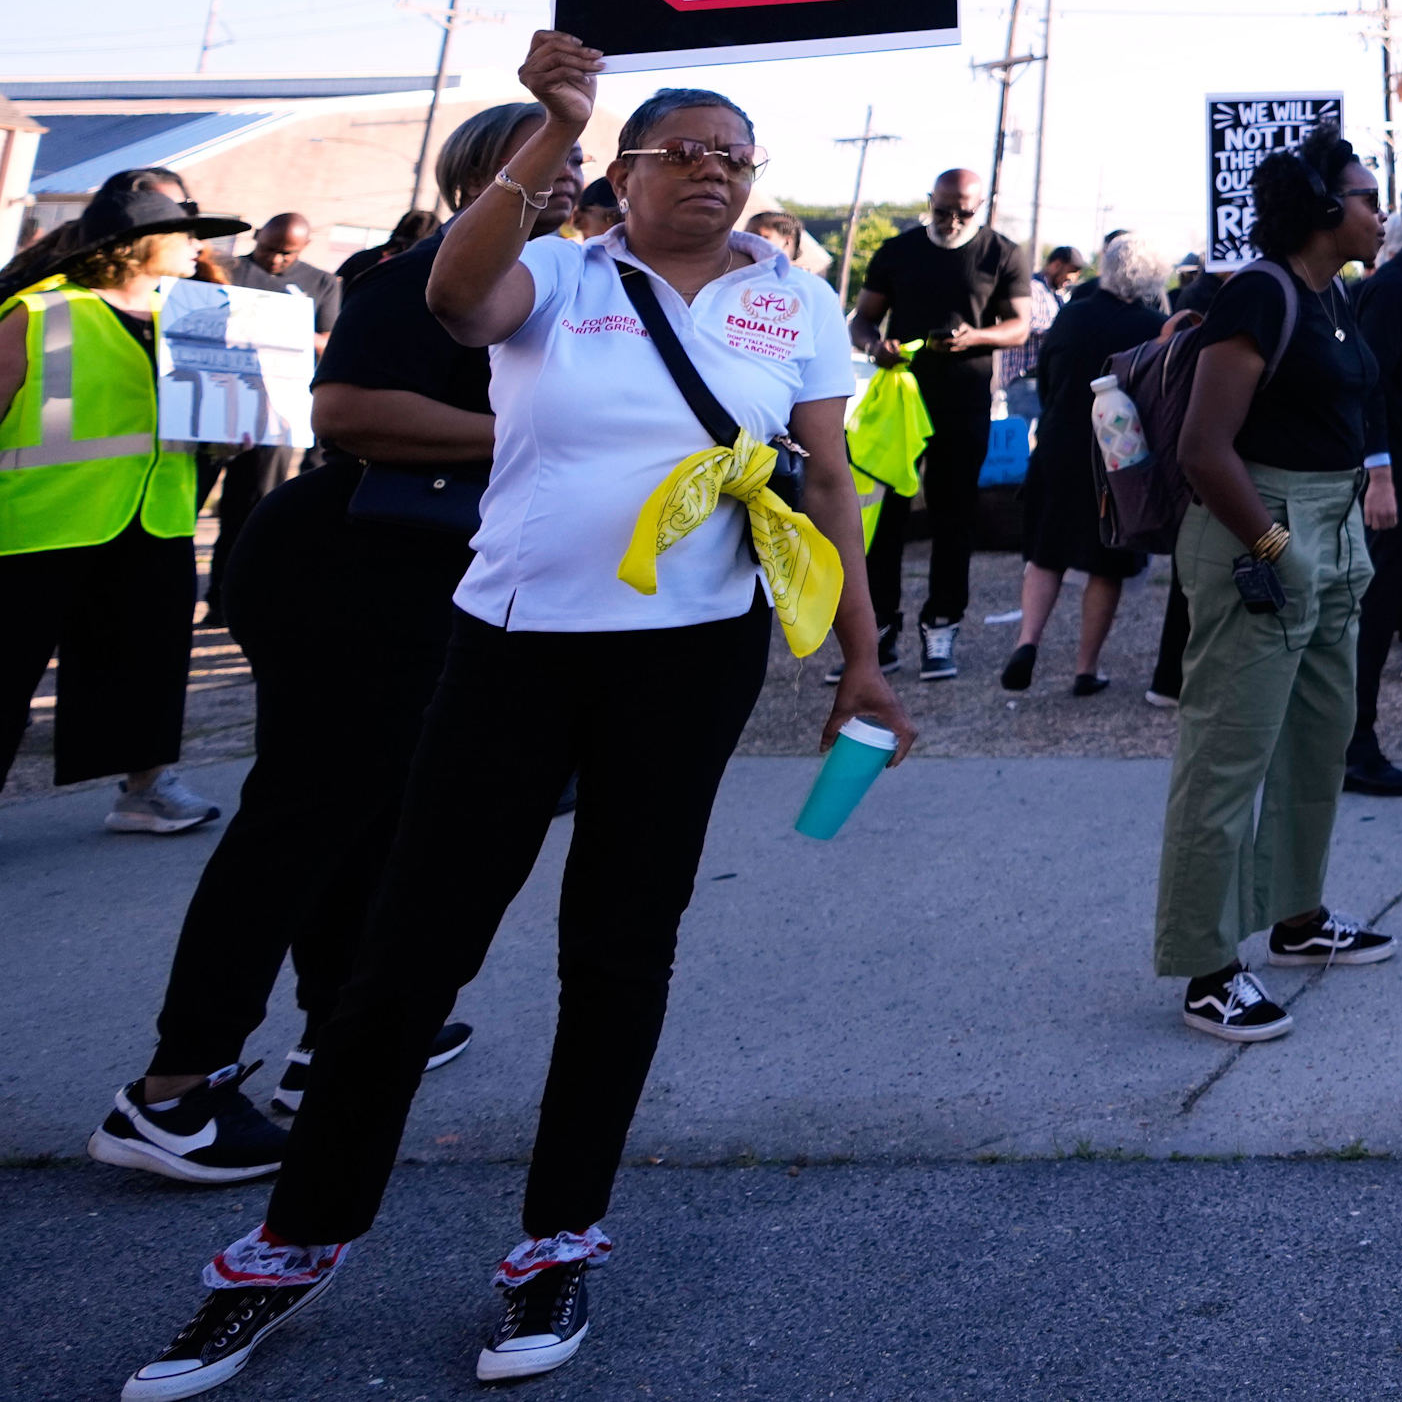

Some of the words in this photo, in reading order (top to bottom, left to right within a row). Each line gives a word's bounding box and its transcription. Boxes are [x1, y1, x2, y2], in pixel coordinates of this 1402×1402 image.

[1238, 102, 1270, 125] WE
[1272, 101, 1316, 121] WILL
[1224, 127, 1279, 150] NOT
[1285, 125, 1318, 147] LE
[582, 315, 637, 327] FOUNDER
[727, 314, 799, 341] EQUALITY
